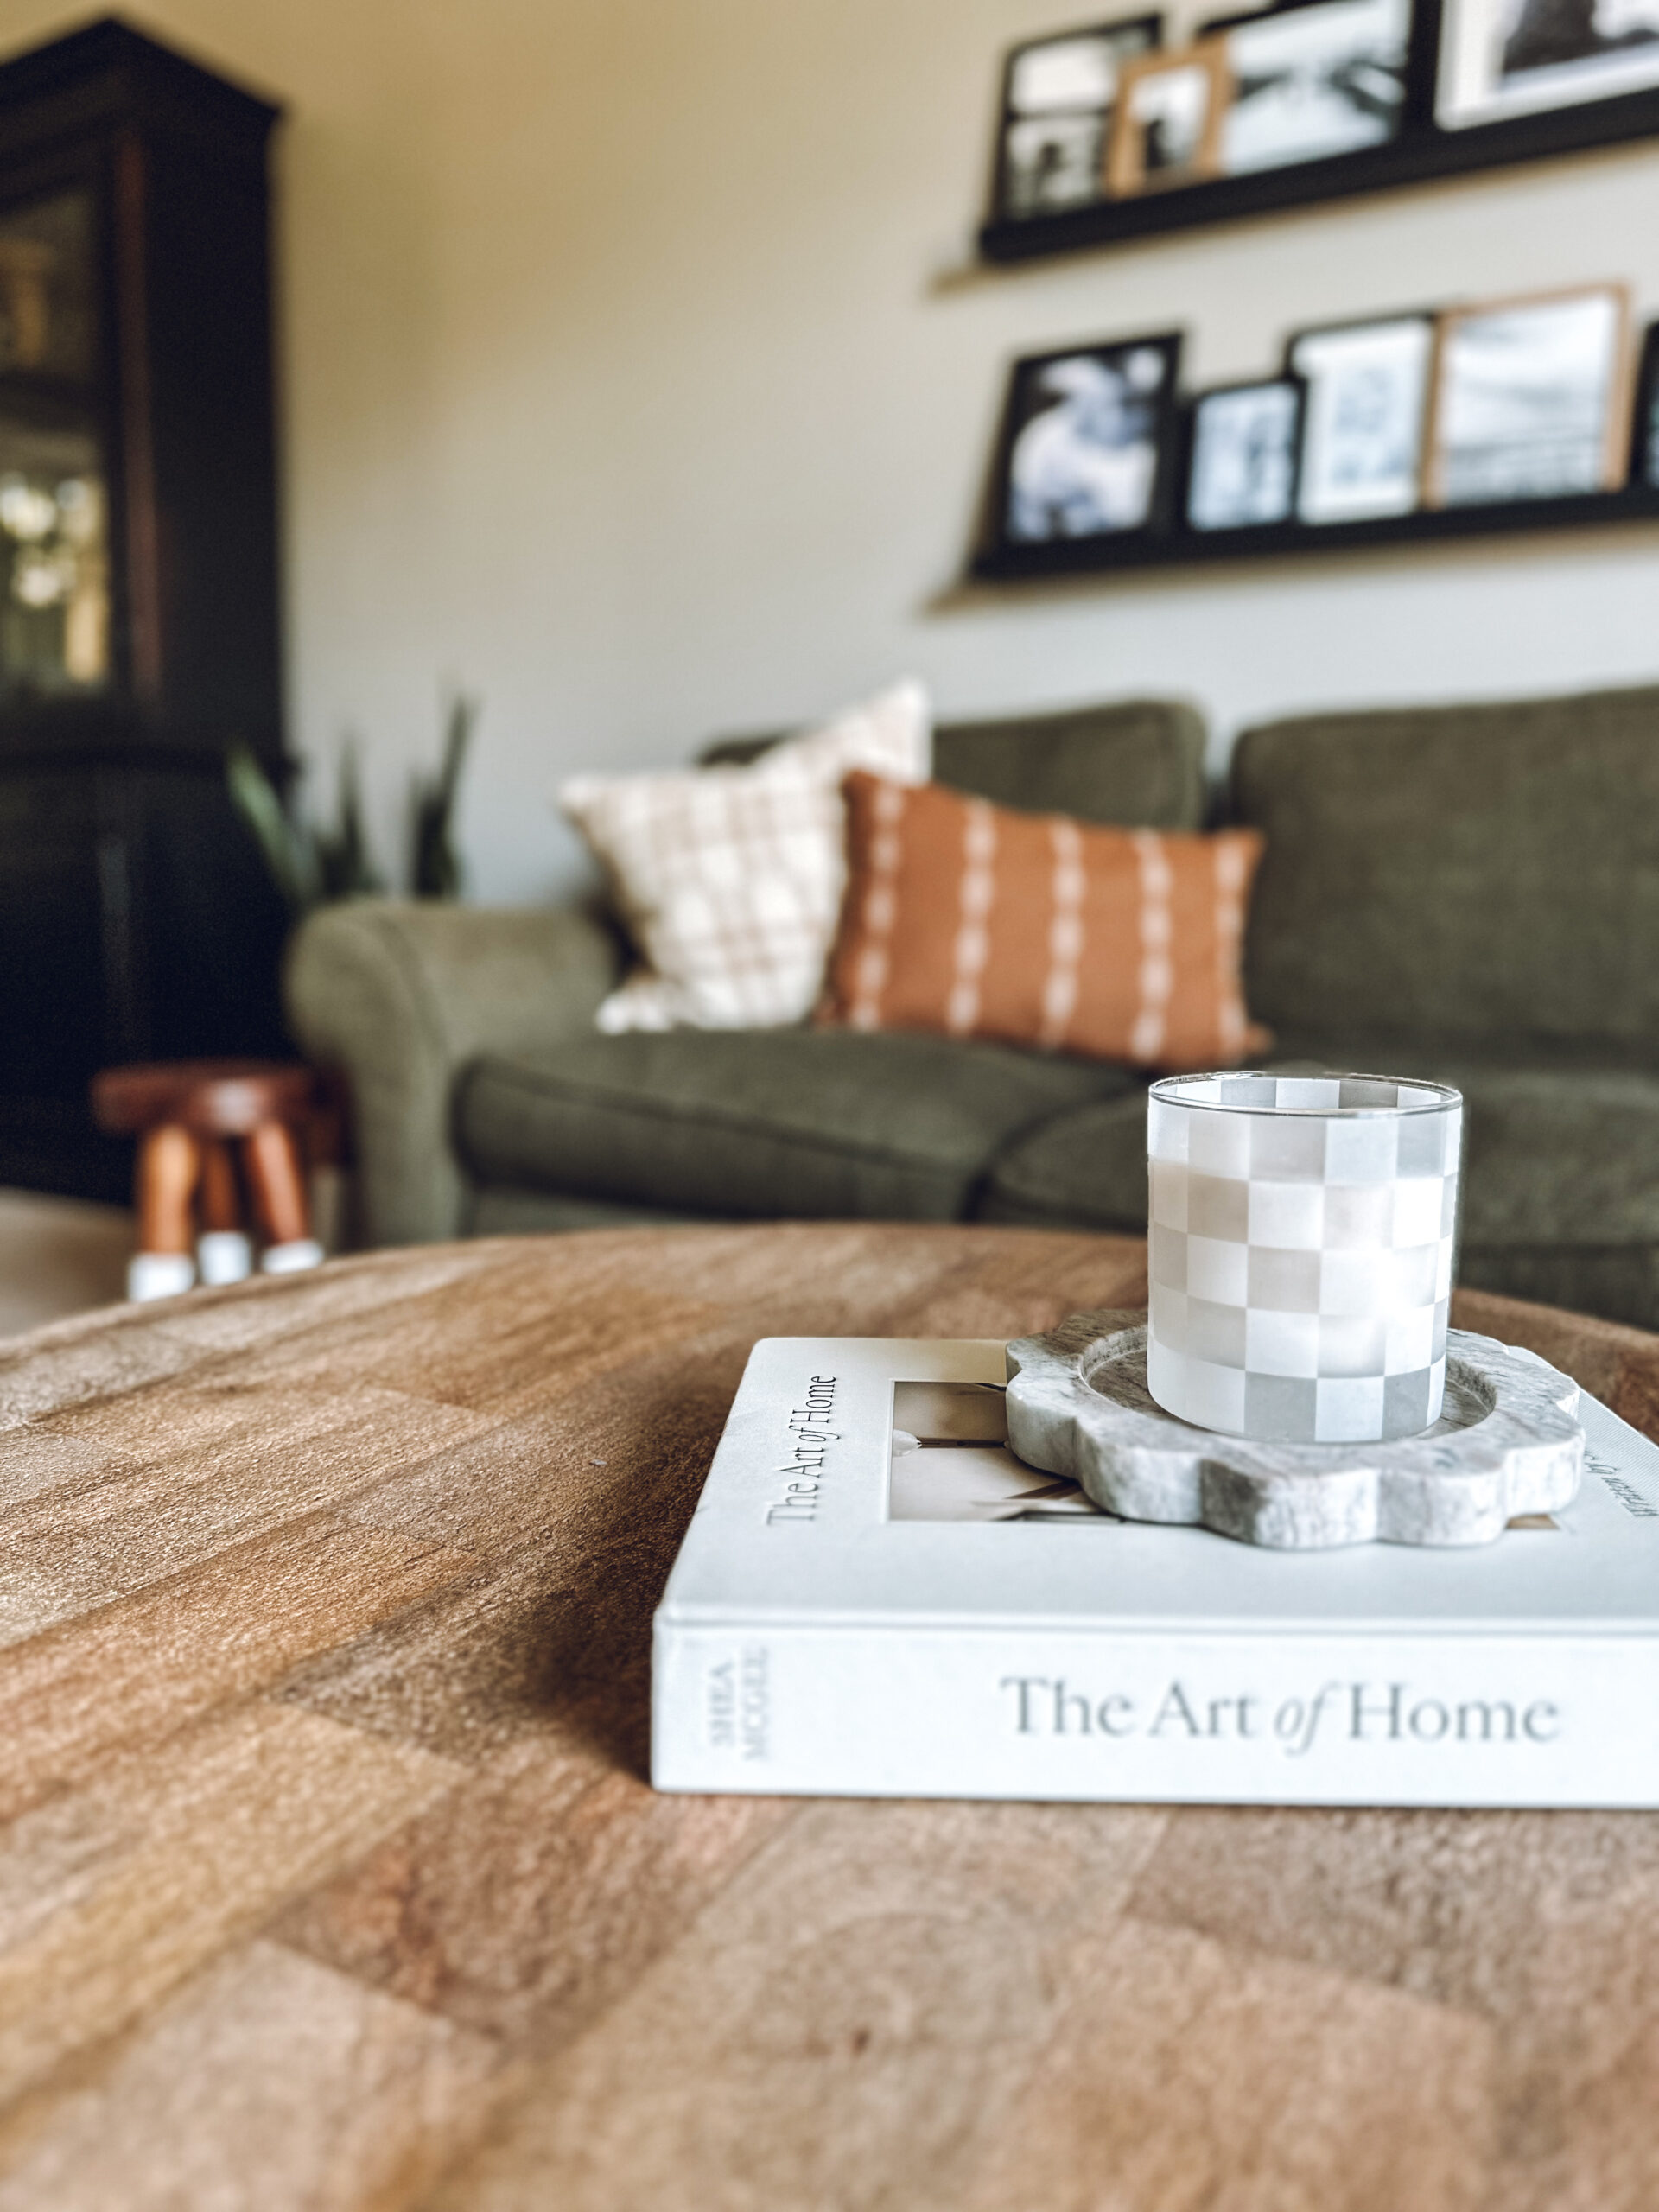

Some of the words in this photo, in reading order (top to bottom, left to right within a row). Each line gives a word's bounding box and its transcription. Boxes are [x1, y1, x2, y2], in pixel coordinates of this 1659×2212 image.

[790, 1376, 836, 1423] Home
[788, 1425, 841, 1442] of
[779, 1447, 824, 1478] Art
[766, 1483, 818, 1525] The
[707, 1658, 734, 1747] SHEA
[999, 1675, 1134, 1737] The
[1147, 1678, 1258, 1739] Art
[1273, 1679, 1344, 1758] of
[1348, 1681, 1561, 1742] Home
